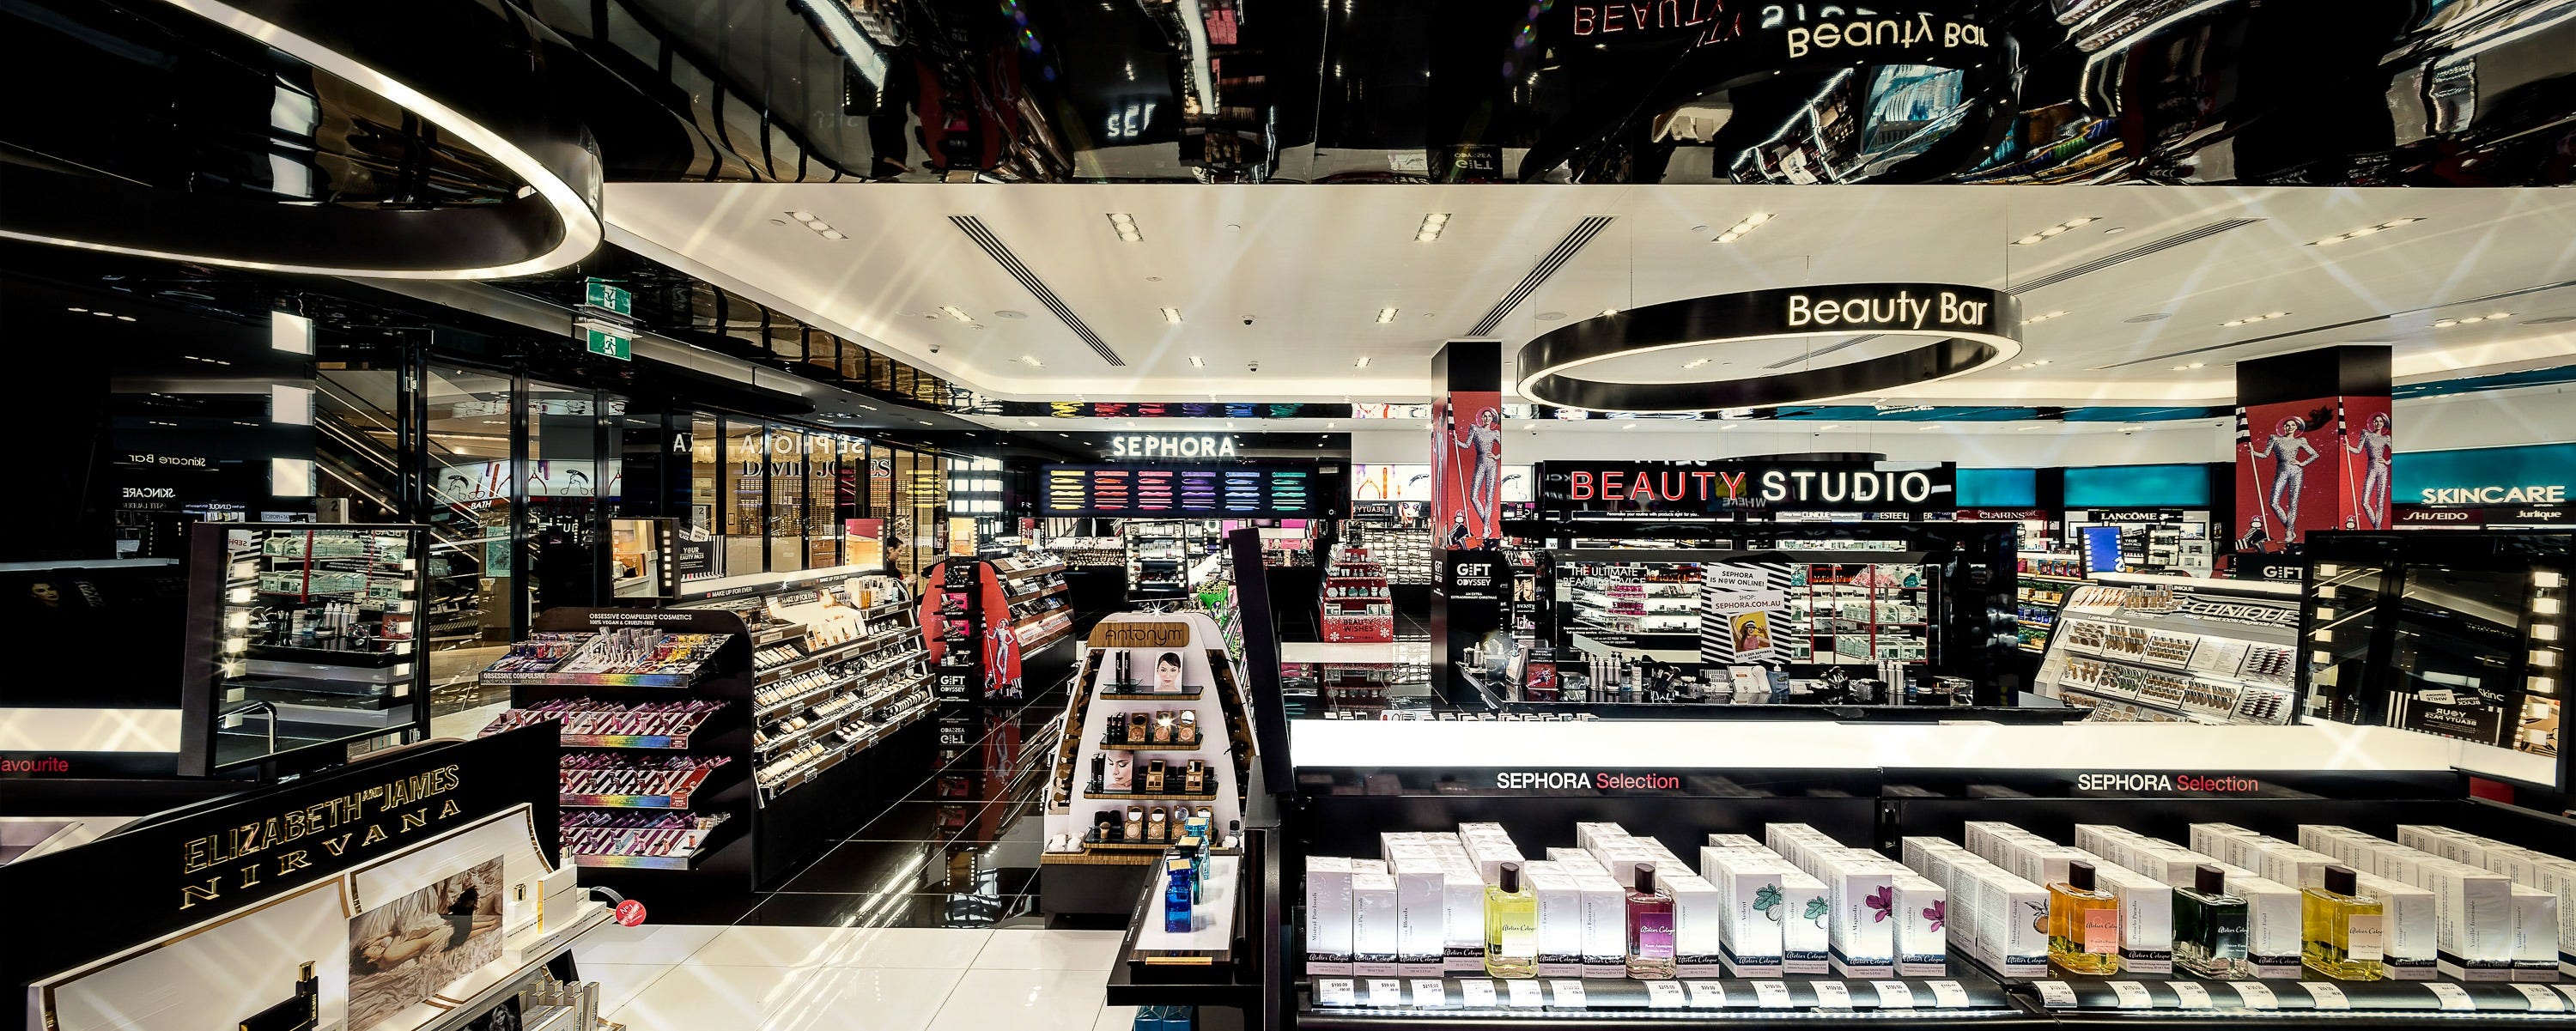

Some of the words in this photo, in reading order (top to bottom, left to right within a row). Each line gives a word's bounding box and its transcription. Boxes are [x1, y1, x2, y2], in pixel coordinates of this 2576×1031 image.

[1789, 291, 1930, 330] Beauty
[1940, 292, 1987, 324] Bar
[1113, 436, 1236, 457] SEPHORA
[816, 459, 892, 477] JOES
[1571, 471, 1746, 501] BEAUTY
[1761, 470, 1931, 502] STUDIO
[2421, 485, 2565, 504] SKINCARE
[471, 500, 491, 509] BATH
[1979, 511, 2025, 519] CLARINS
[2100, 512, 2157, 520] LANCÔME
[2403, 512, 2469, 520] SHISEIDO
[2516, 511, 2561, 521] Jurlique
[1456, 563, 1492, 576] GIFT
[1571, 567, 1591, 577] THE
[1592, 567, 1638, 577] ULTIMATE
[1722, 570, 1753, 579] SEPHORA
[2263, 566, 2303, 579] GIFT
[1737, 579, 1765, 587] ONLINE!
[1716, 601, 1781, 610] SEPHORA.COM.AU
[2189, 602, 2299, 622] CLINIQUE
[1105, 625, 1182, 646] Antonym
[940, 676, 965, 685] GIFT
[1497, 773, 1591, 789] SEPHORA
[1595, 773, 1680, 789] Selection
[2078, 774, 2172, 791] SEPHORA
[2177, 774, 2259, 791] Selection
[184, 792, 361, 875] ELIZABETH
[361, 786, 384, 802] AND
[380, 764, 459, 811] JAMES
[179, 799, 461, 910] NIRVANA
[1443, 948, 1462, 956] Atelier
[1463, 948, 1483, 956] Cologne
[1786, 951, 1806, 960] Atelier
[1807, 951, 1827, 960] Cologne
[2129, 951, 2148, 960] Atelier
[2149, 951, 2170, 960] Cologne
[1539, 954, 1558, 963] Atelier
[1558, 954, 1579, 963] Cologne
[2007, 955, 2026, 964] Atelier
[2027, 955, 2047, 964] Cologne
